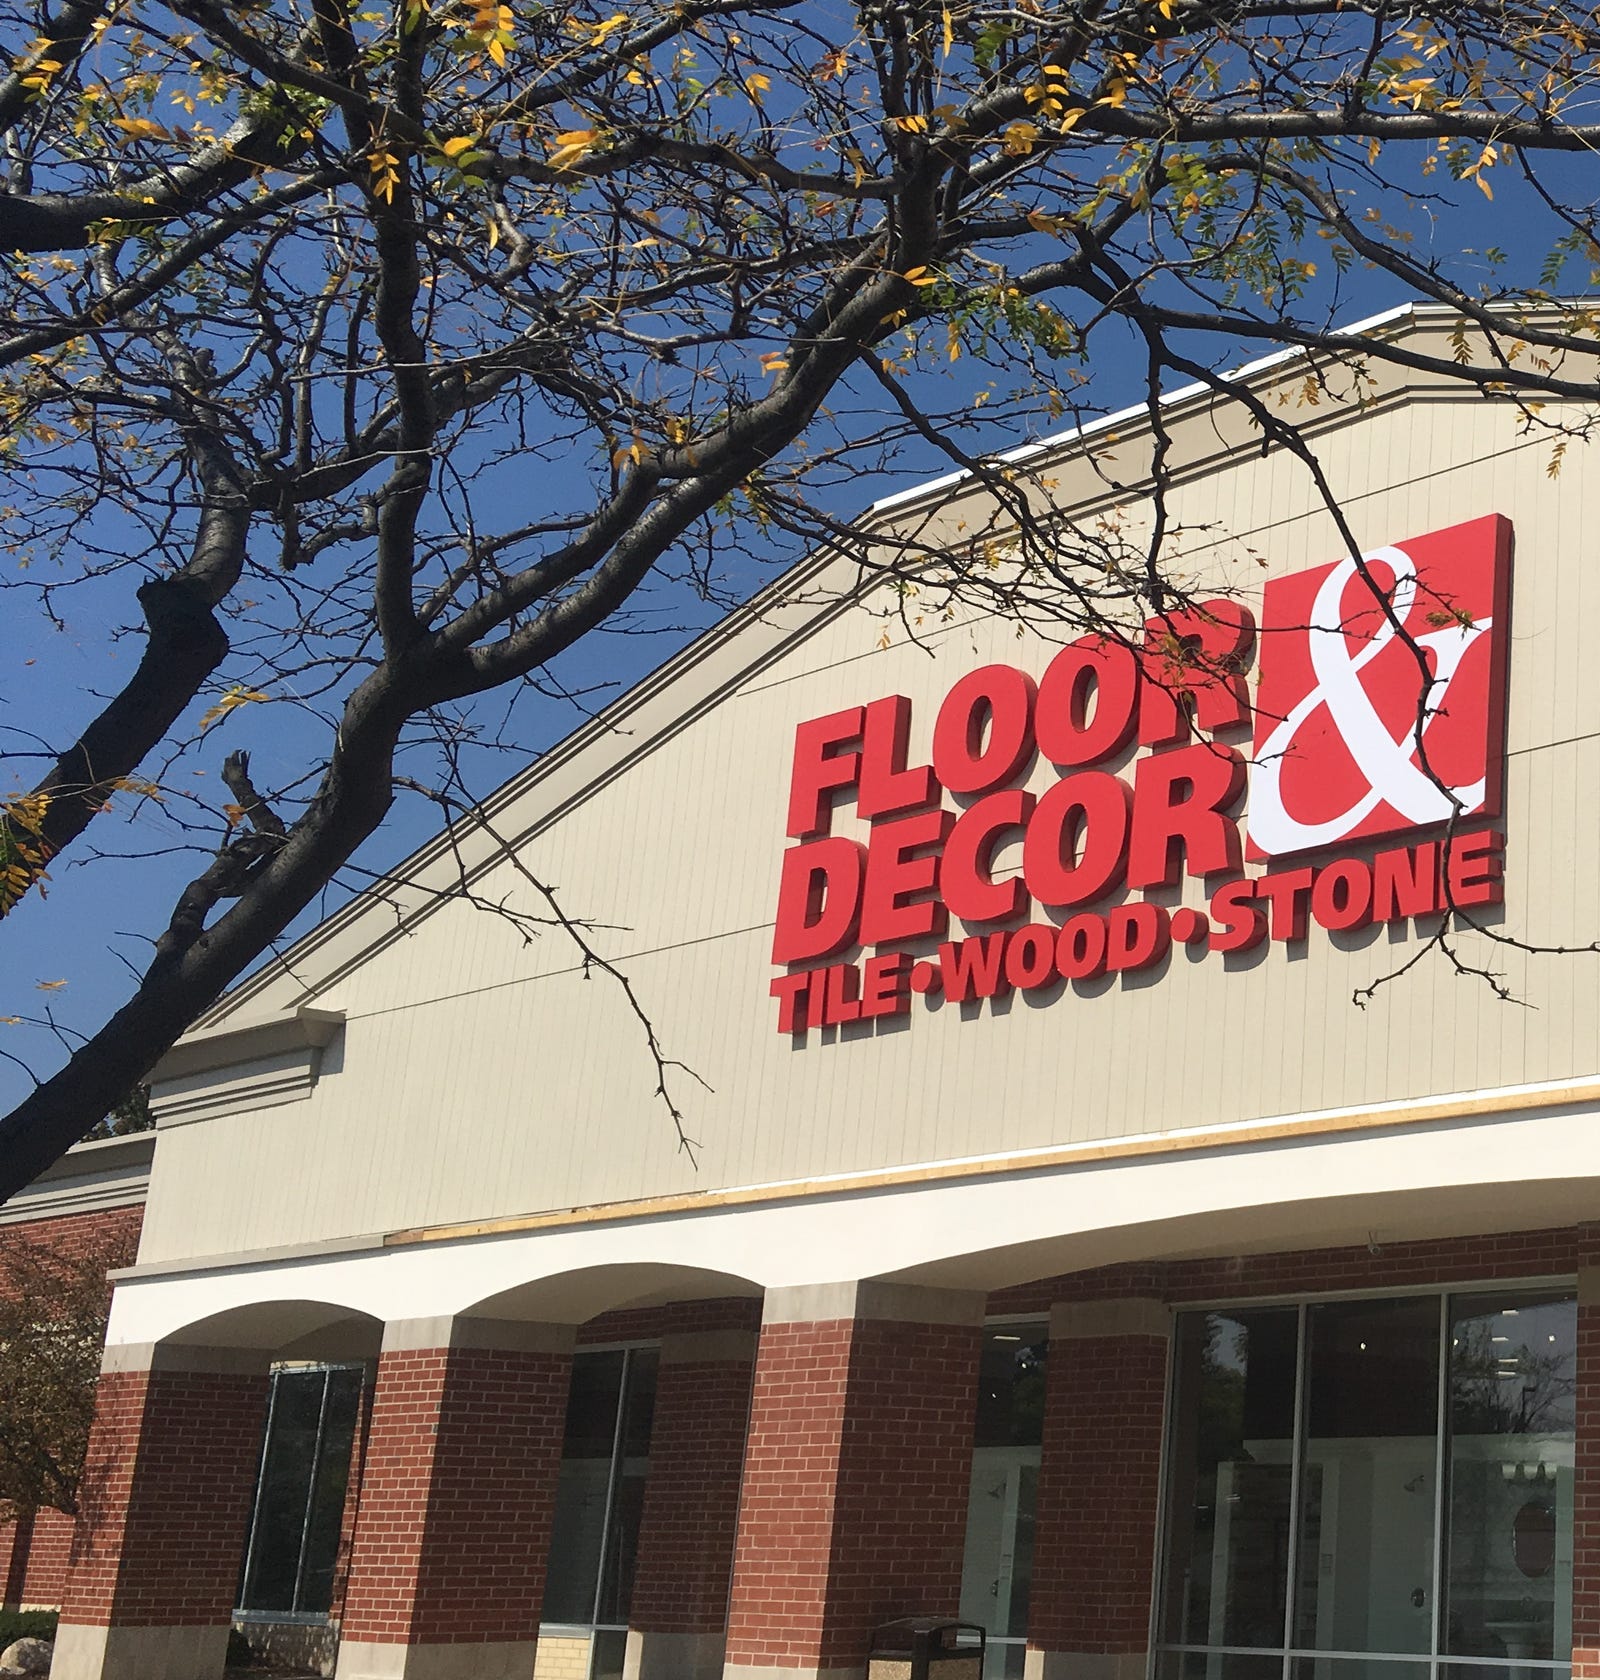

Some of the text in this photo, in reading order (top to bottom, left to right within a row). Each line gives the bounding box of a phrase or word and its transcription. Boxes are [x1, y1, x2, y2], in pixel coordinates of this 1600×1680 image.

[788, 545, 1492, 855] FLOOR &
[770, 829, 1504, 1034] TILE WOOD STONE
[771, 742, 1242, 966] DECOR
